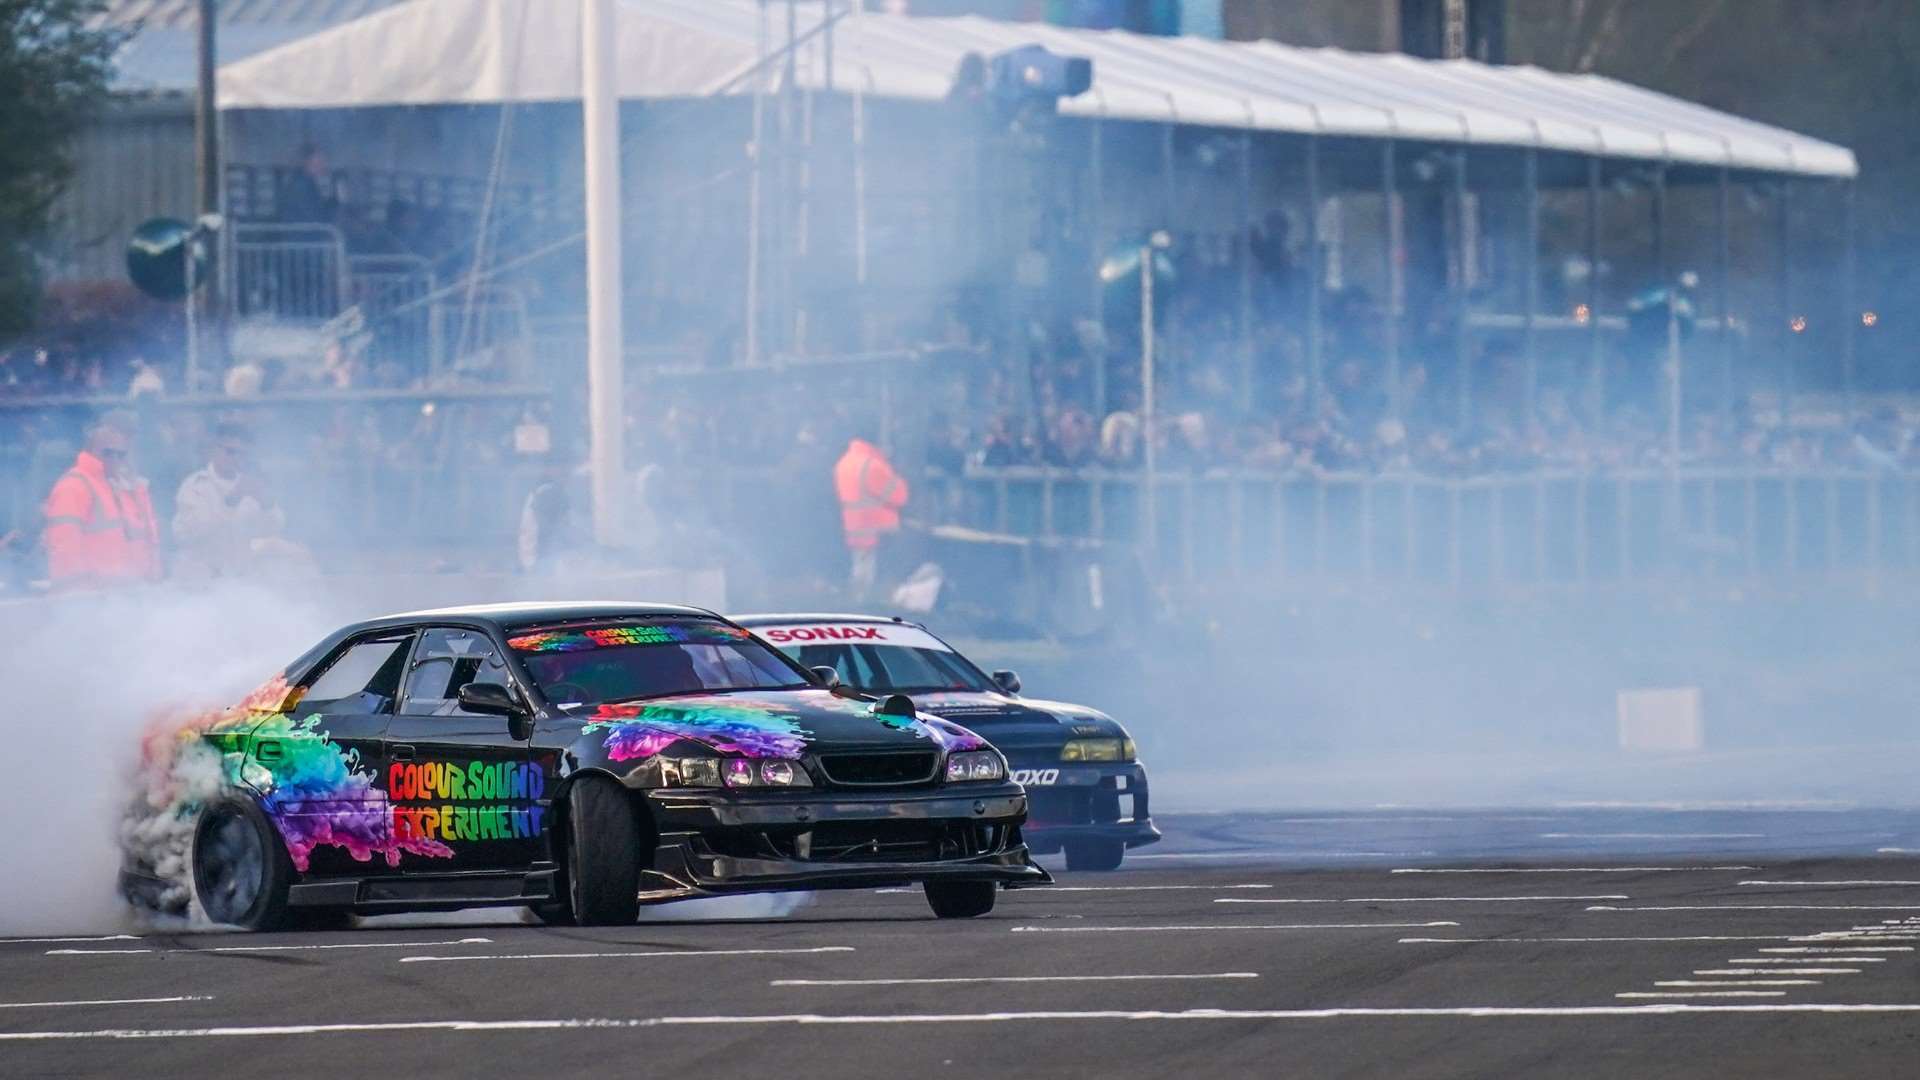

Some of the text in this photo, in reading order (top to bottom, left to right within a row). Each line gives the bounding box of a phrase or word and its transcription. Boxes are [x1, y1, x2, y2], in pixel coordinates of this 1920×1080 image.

[766, 626, 888, 642] SONAX
[389, 761, 544, 800] COLOUR SOUND
[394, 805, 545, 841] EXPERIMENT
